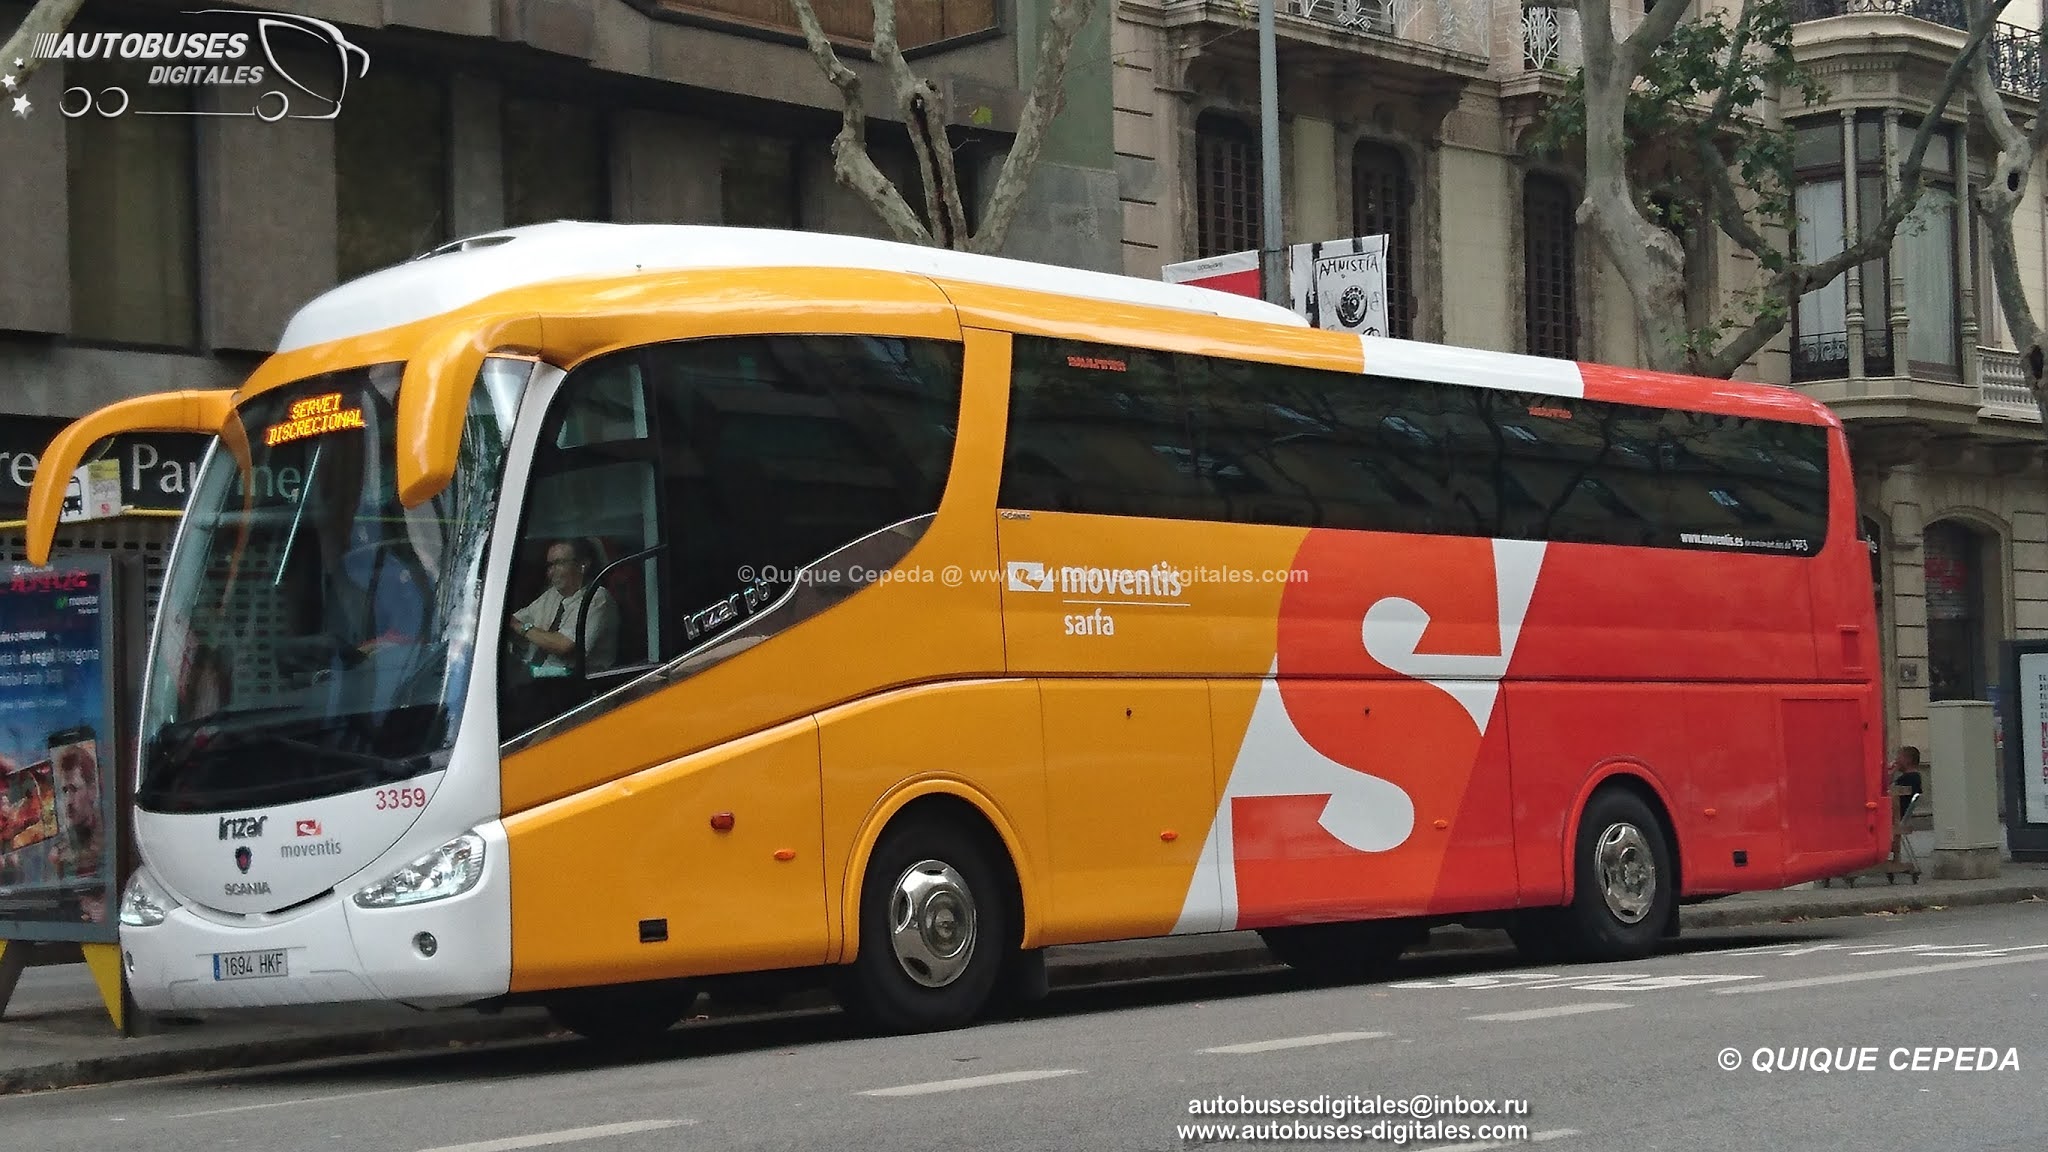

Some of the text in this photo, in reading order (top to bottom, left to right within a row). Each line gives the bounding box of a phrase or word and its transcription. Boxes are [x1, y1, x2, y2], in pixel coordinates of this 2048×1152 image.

[291, 393, 342, 420] SERVEI
[266, 409, 366, 446] DISCRECIONAL
[1061, 561, 1182, 597] moventis
[1064, 608, 1115, 636] sarfa
[376, 788, 426, 810] 3359
[280, 839, 342, 858] moventis
[224, 881, 272, 896] SCANIA
[224, 953, 283, 976] 1694 HKF
